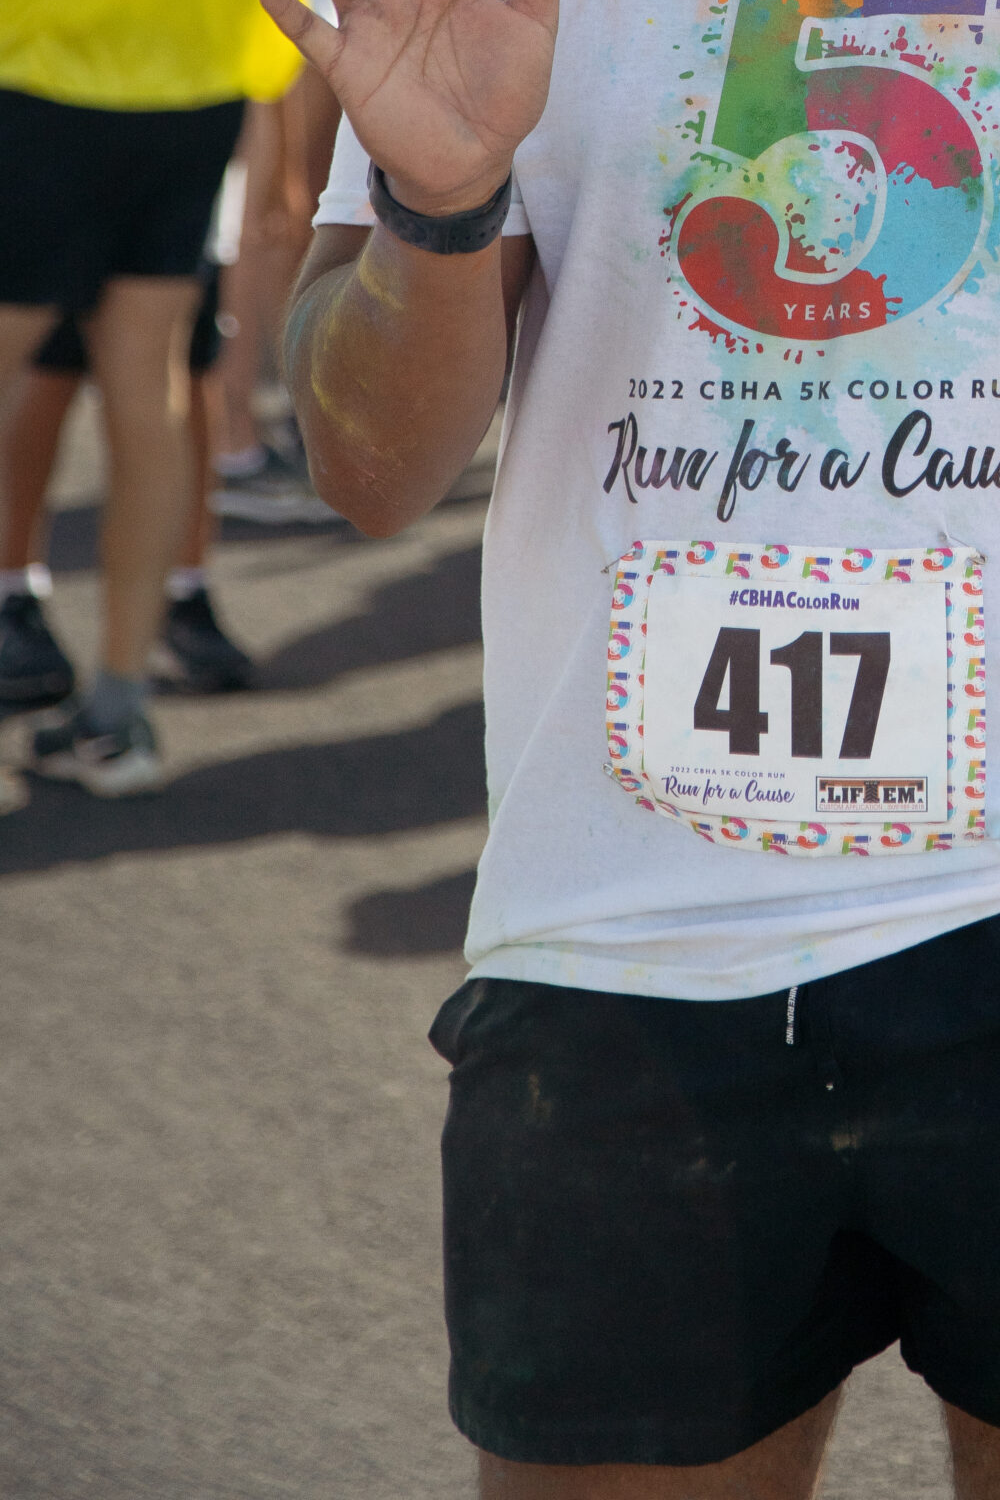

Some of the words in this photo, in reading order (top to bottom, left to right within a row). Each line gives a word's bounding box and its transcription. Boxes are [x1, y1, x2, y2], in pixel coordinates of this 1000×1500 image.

[783, 302, 872, 322] YEARS
[629, 378, 684, 400] 2022
[699, 380, 783, 401] CBHA
[800, 380, 832, 401] 5K
[847, 379, 955, 400] COLOR
[602, 411, 719, 504] Run
[716, 419, 811, 522] for
[819, 448, 871, 492] a
[693, 626, 891, 760] 417
[670, 766, 691, 774] 2022
[694, 767, 717, 775] CBHA
[735, 770, 764, 778] COLOR
[661, 775, 700, 798] Run
[702, 779, 726, 805] for
[729, 786, 742, 799] a
[745, 780, 795, 803] Cause
[788, 986, 798, 1007] NIKE
